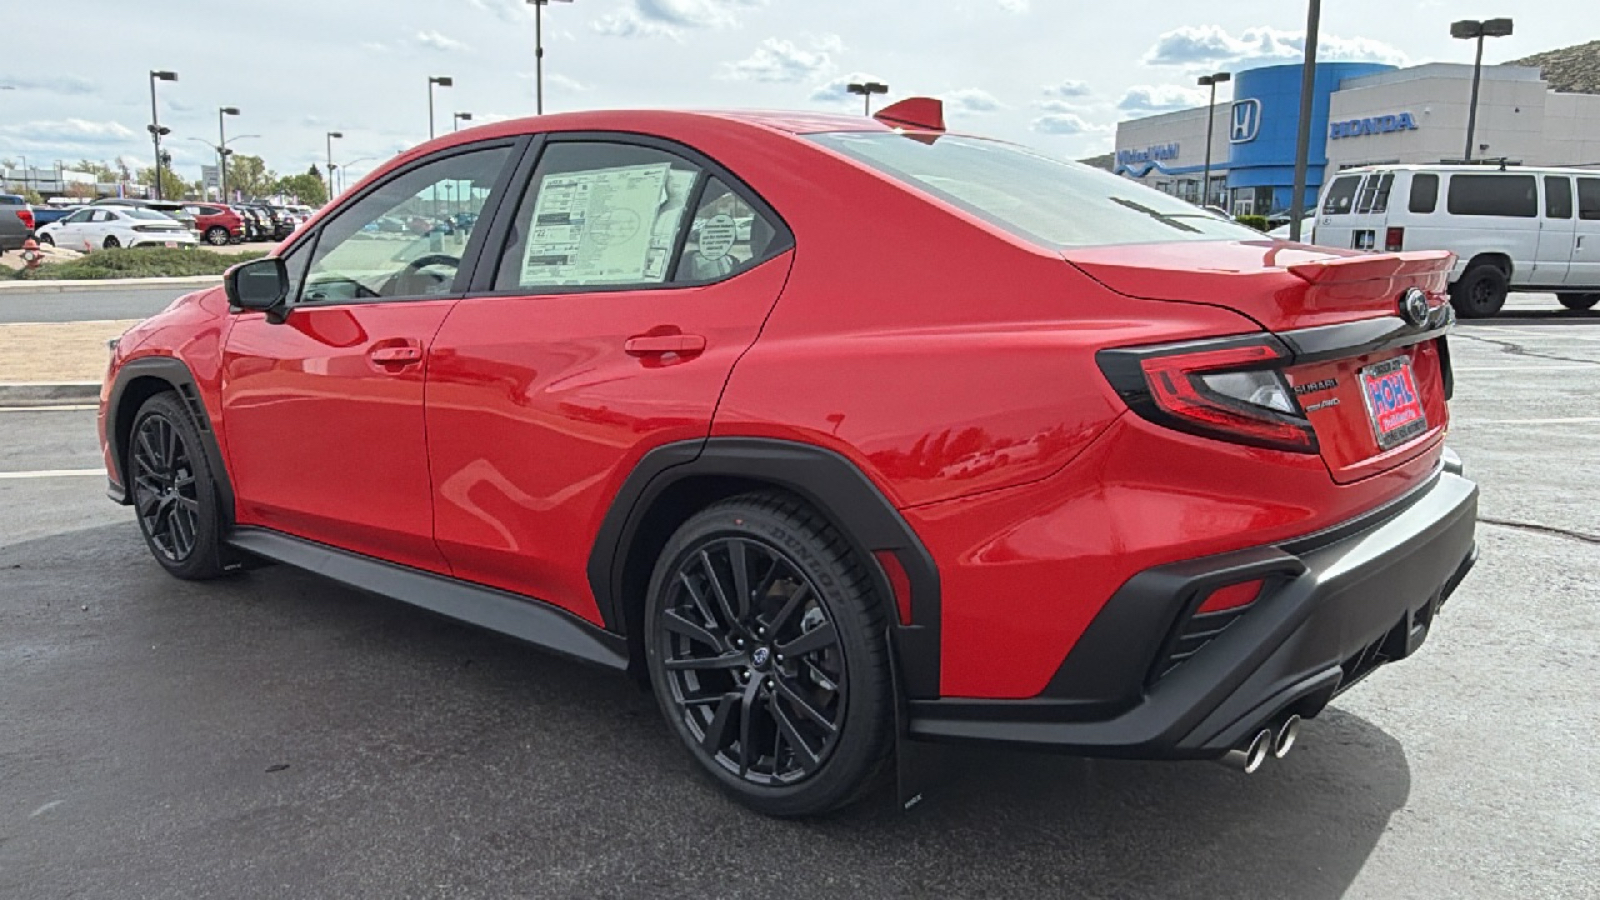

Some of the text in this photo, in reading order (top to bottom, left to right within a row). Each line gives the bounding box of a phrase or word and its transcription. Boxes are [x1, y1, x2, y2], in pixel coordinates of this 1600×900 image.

[1330, 112, 1418, 140] HONDA
[1369, 374, 1413, 413] HOHL
[769, 526, 843, 602] DUNLOP
